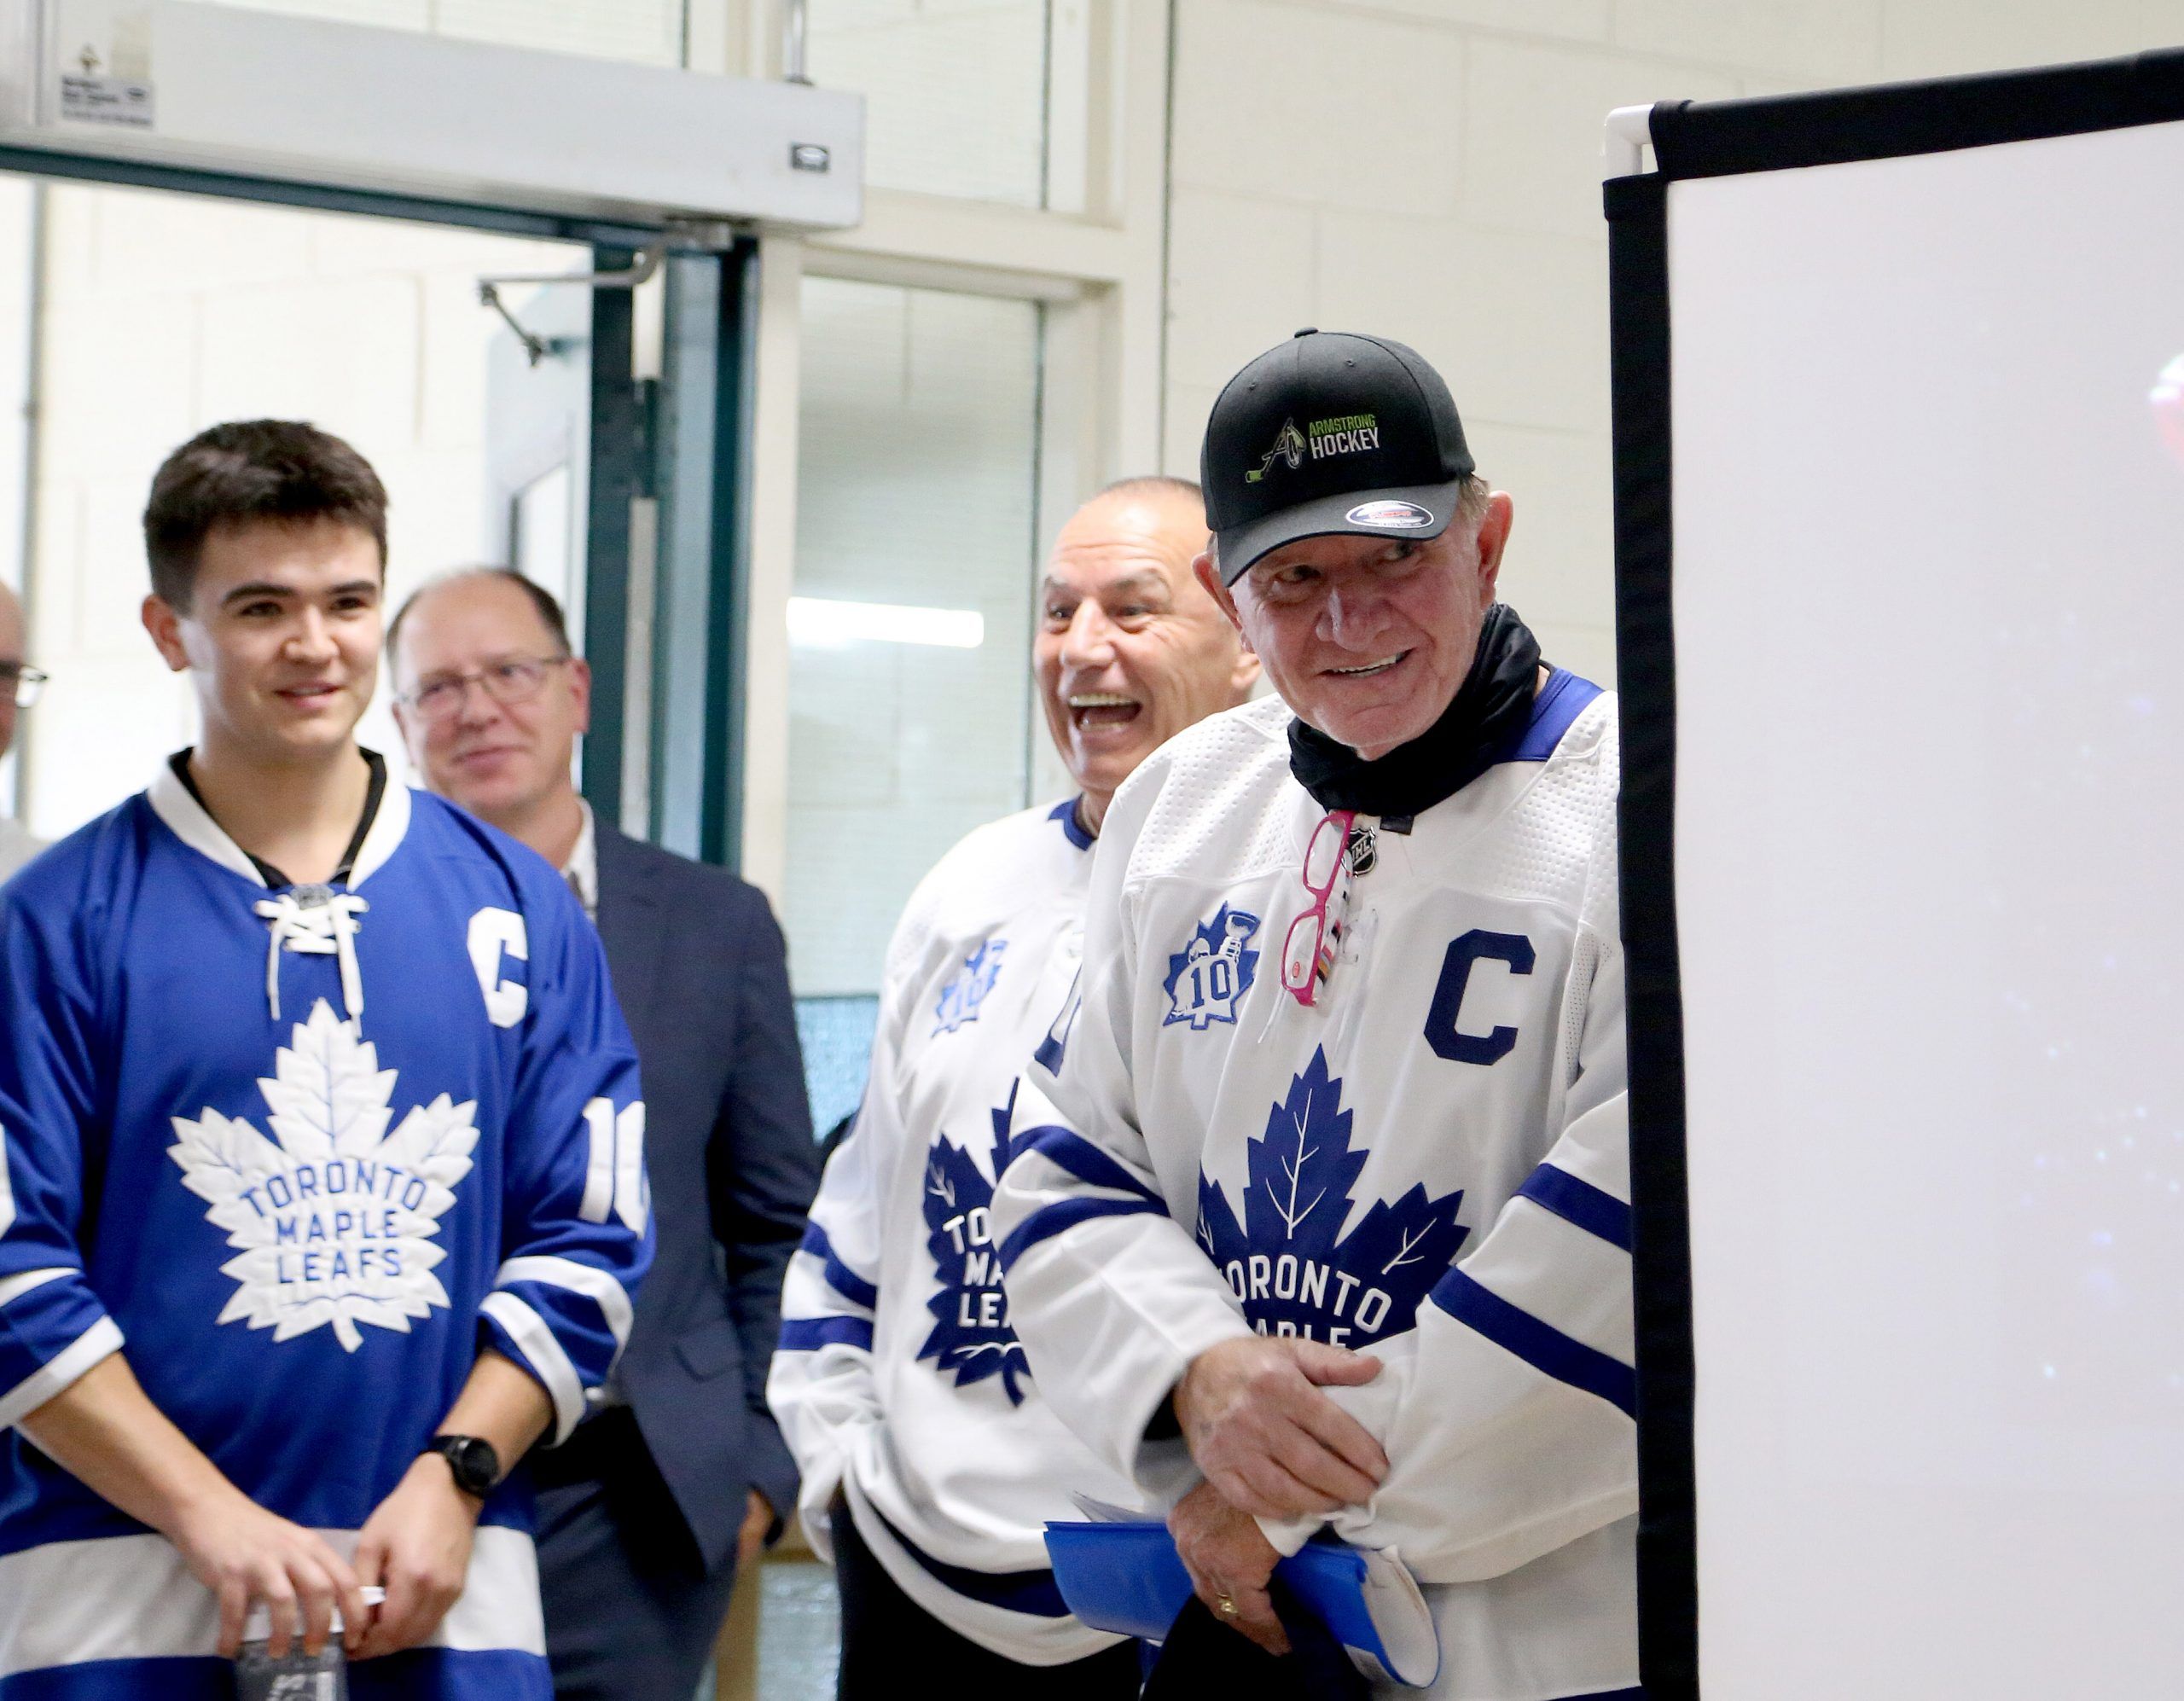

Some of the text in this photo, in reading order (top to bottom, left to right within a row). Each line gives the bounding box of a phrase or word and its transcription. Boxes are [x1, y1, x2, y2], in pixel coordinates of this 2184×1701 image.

[1309, 414, 1376, 437] ARMSTRONG
[1310, 427, 1380, 459] HOCKEY
[467, 906, 529, 1029] C
[1192, 958, 1231, 1007] 10
[1423, 928, 1536, 1066] C
[240, 1161, 427, 1218] TORONTO
[276, 1208, 401, 1244] MAPLE
[277, 1247, 404, 1285] LEAFS
[1220, 1254, 1392, 1334] ORONTO
[1254, 1318, 1351, 1348] APLE
